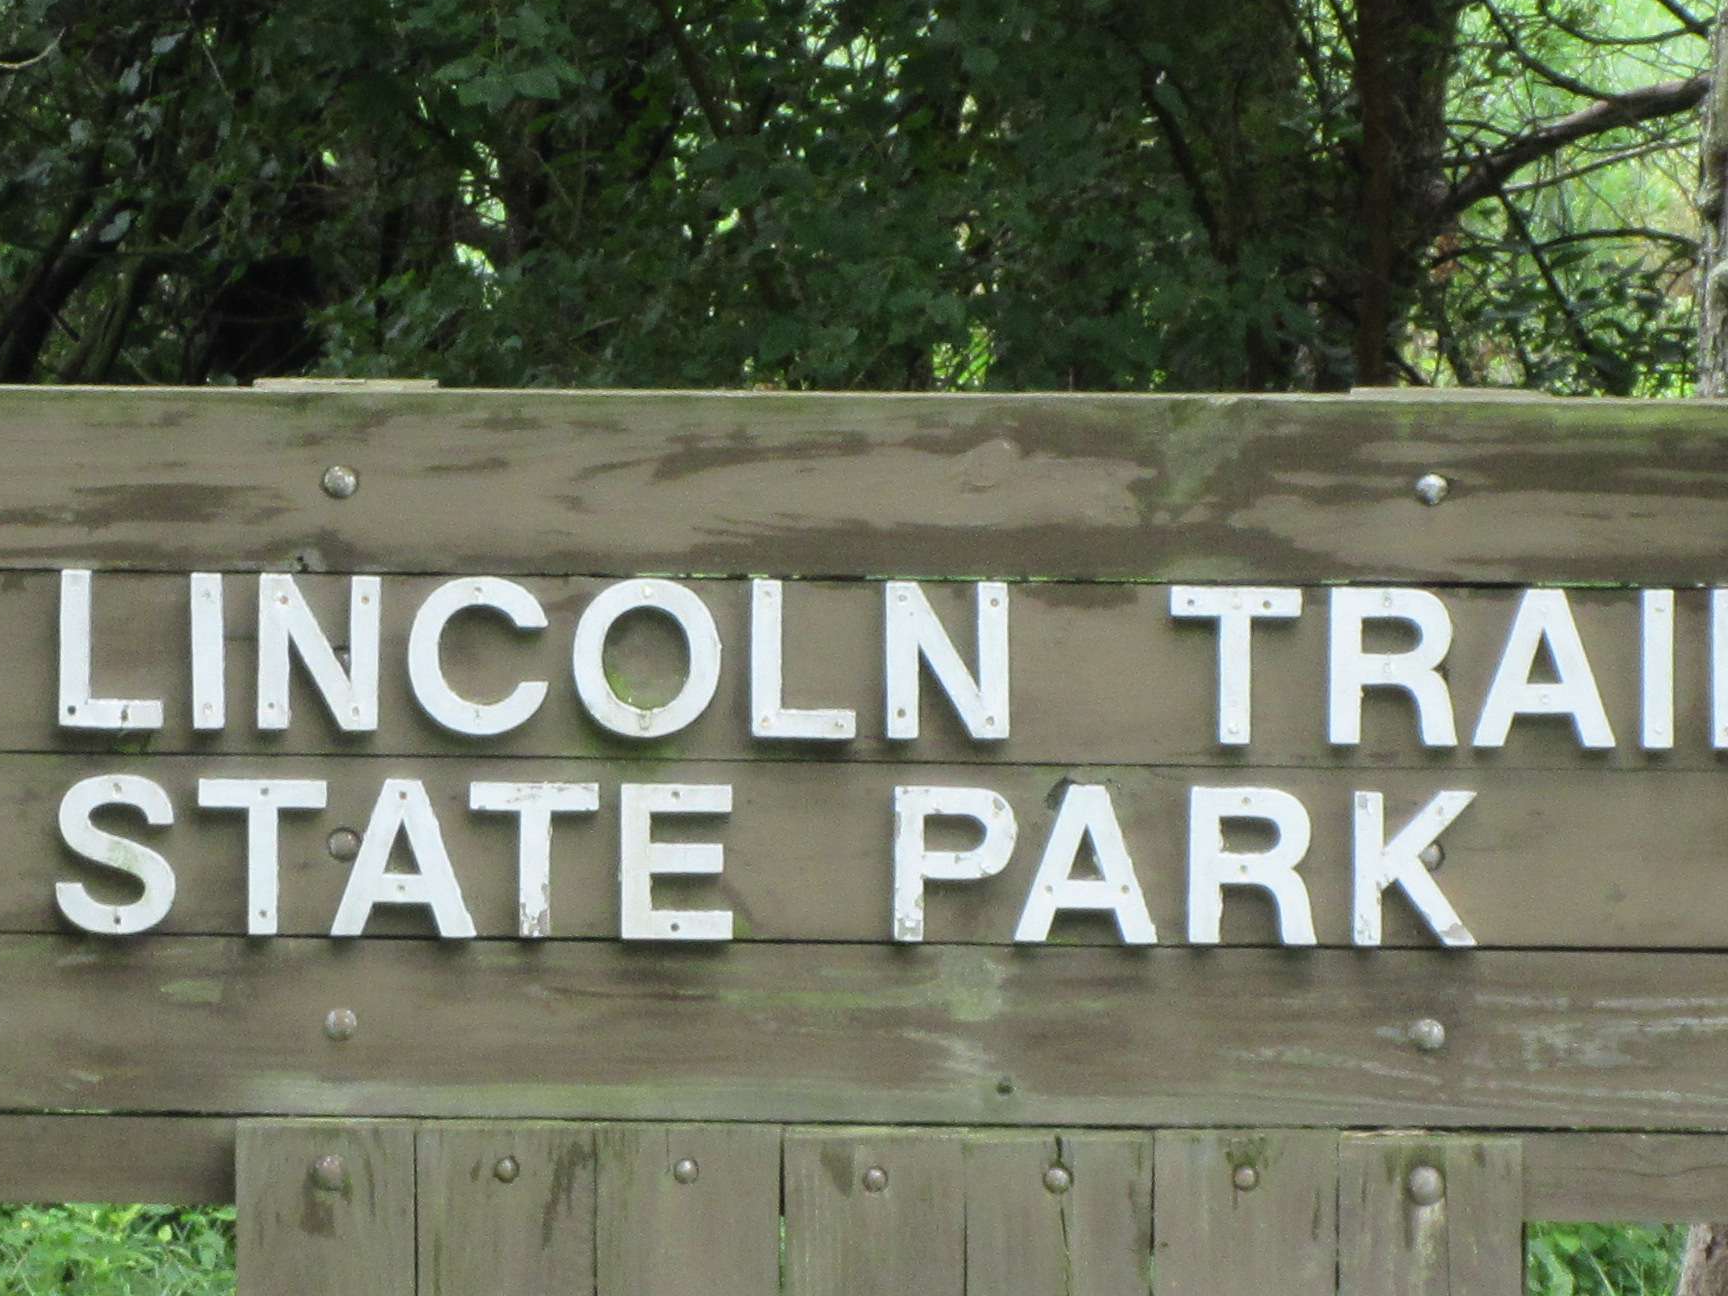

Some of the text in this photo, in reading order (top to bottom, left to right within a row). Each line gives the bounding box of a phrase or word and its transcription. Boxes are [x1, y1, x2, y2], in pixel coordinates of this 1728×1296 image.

[55, 567, 1012, 740] LINCOLN
[53, 772, 1478, 947] STATE PARK
